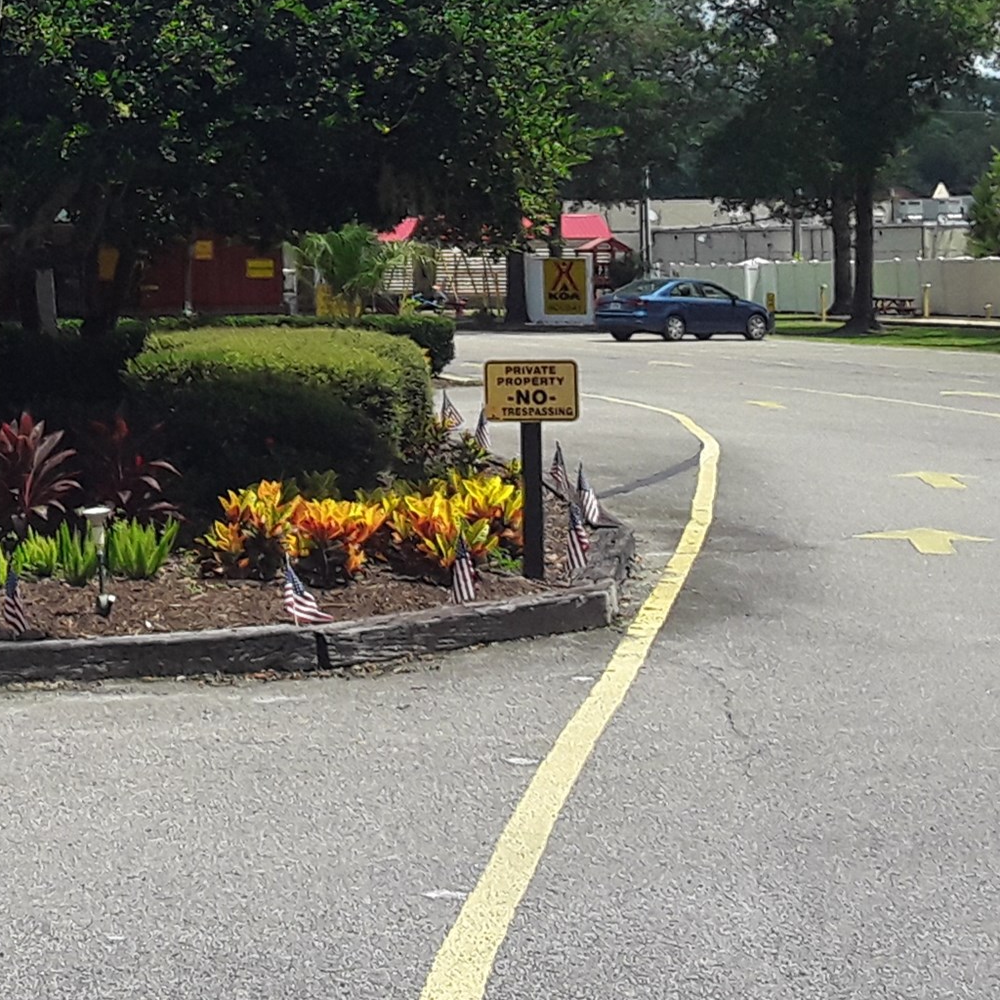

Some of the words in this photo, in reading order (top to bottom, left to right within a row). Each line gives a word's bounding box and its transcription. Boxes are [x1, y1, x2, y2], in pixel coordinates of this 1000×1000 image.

[548, 291, 580, 300] KOA
[505, 366, 556, 375] PRIVATE
[497, 377, 564, 386] PROPERTY
[502, 407, 573, 416] TRESPASSING
